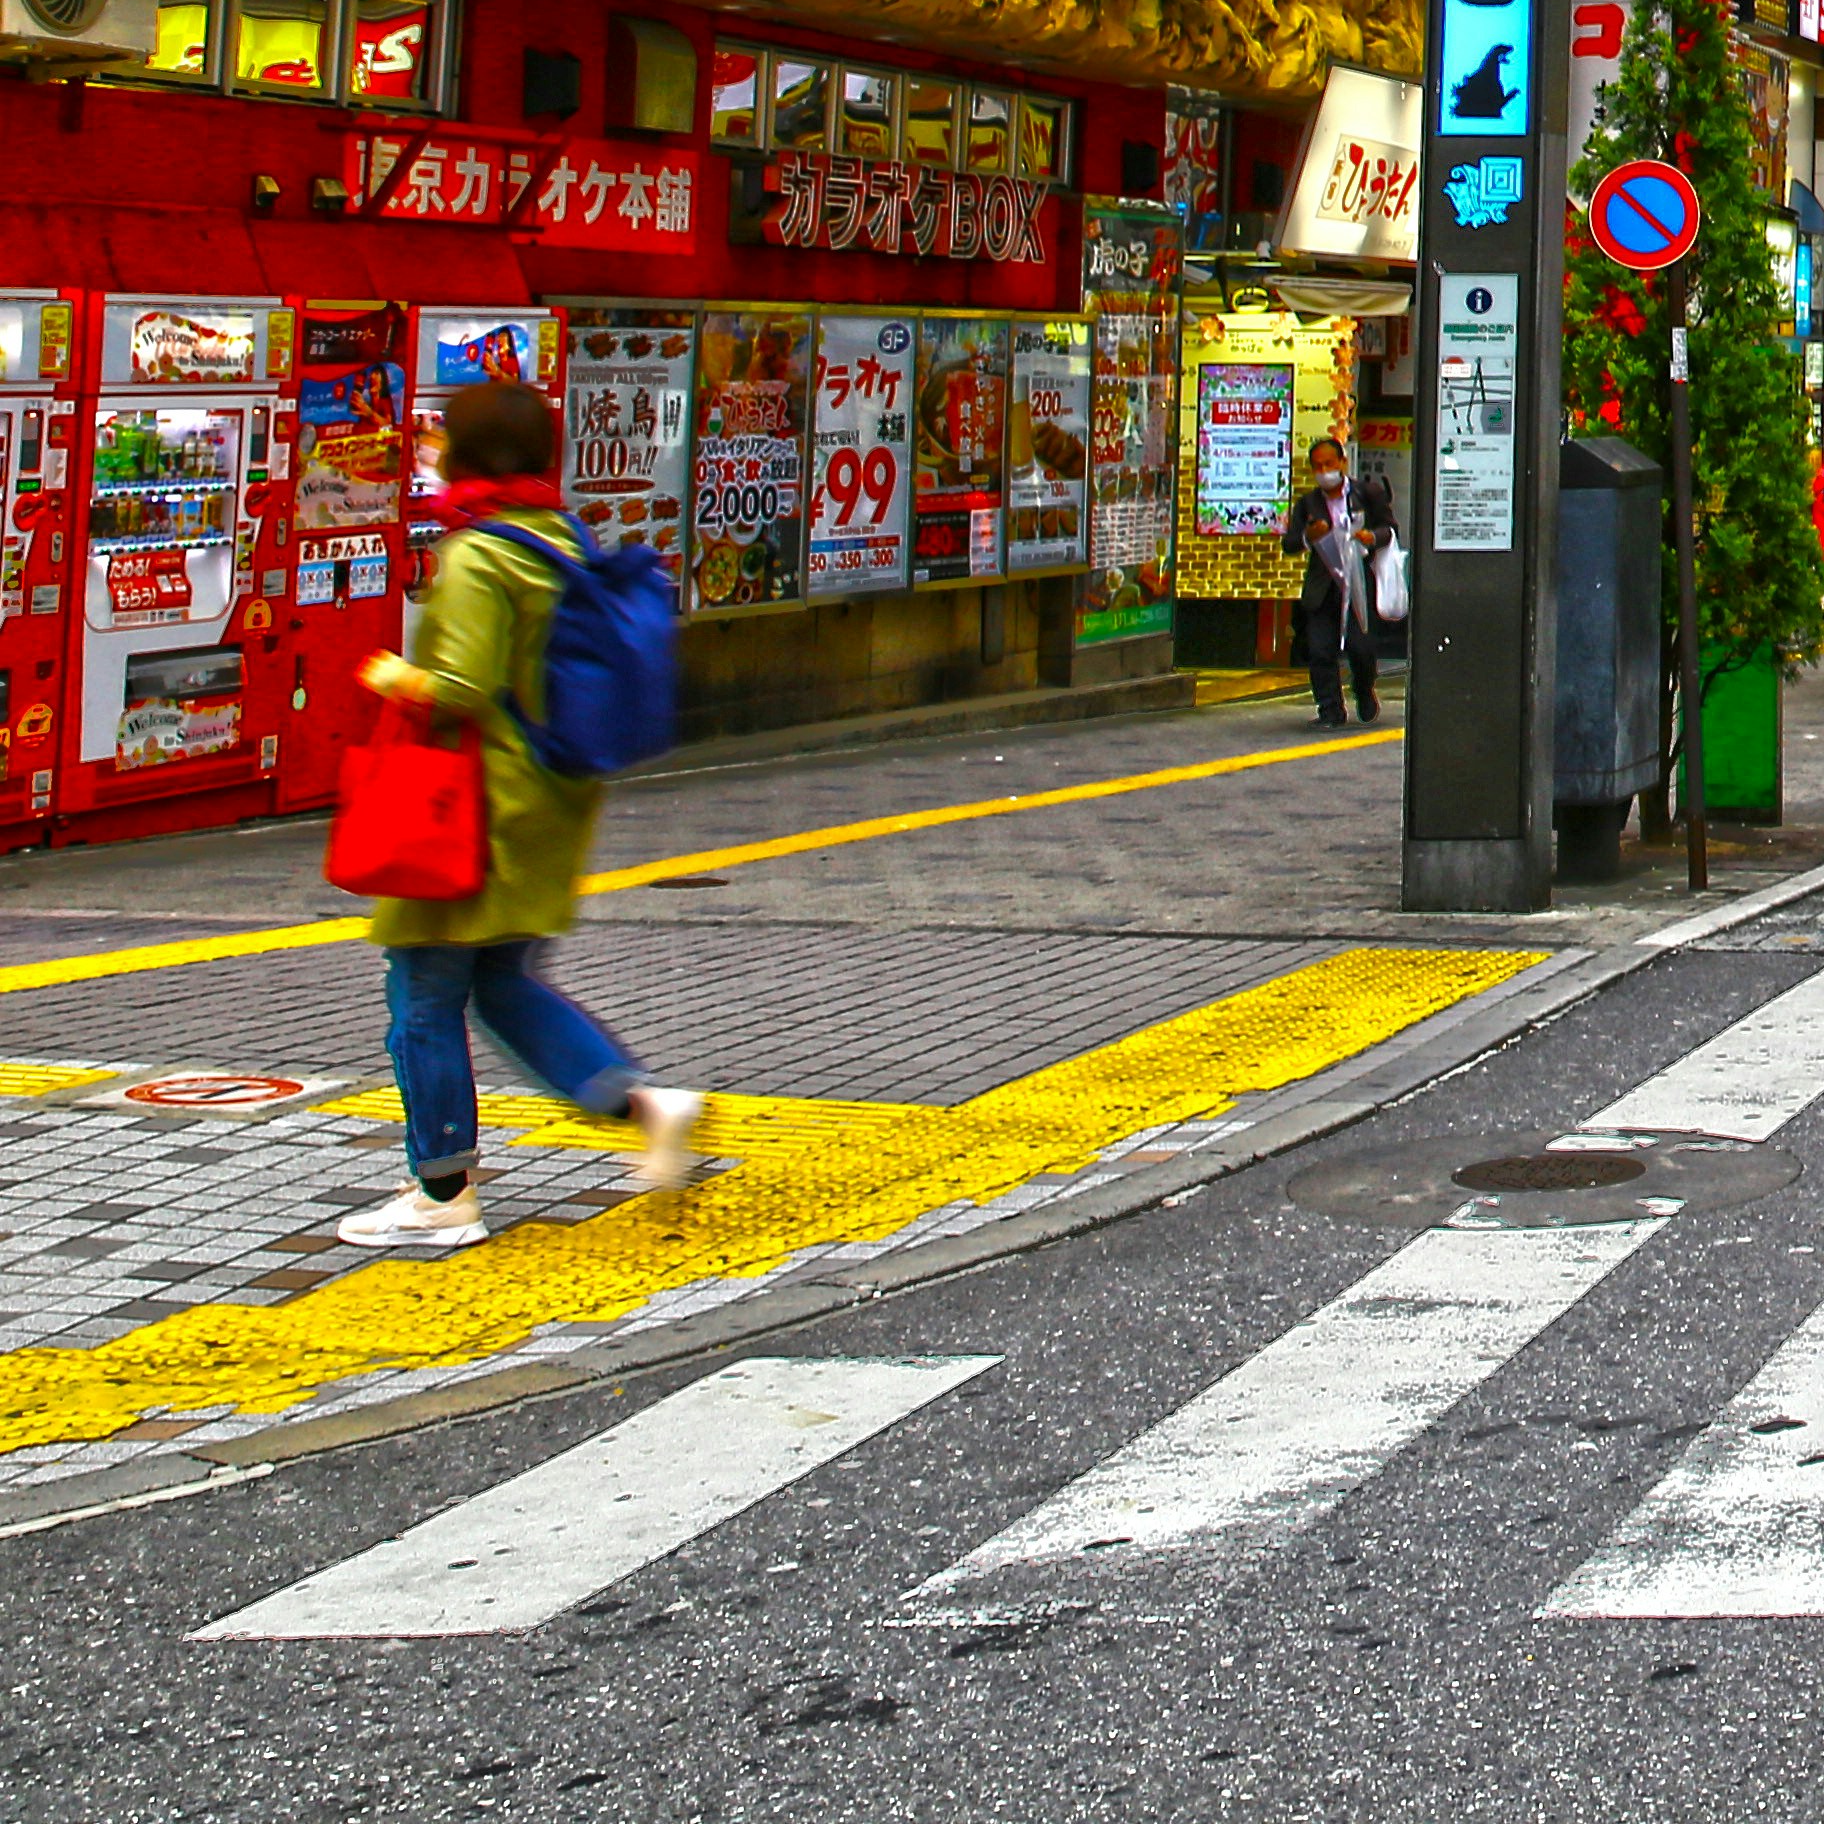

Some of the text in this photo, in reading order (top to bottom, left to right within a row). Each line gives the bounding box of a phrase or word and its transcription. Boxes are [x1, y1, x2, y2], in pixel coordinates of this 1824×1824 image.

[778, 147, 1047, 264] カラオケBOX
[1341, 141, 1417, 223] ひょうたん
[880, 327, 905, 350] 3F
[580, 386, 658, 440] 焼鳥
[574, 438, 660, 479] 100円!!
